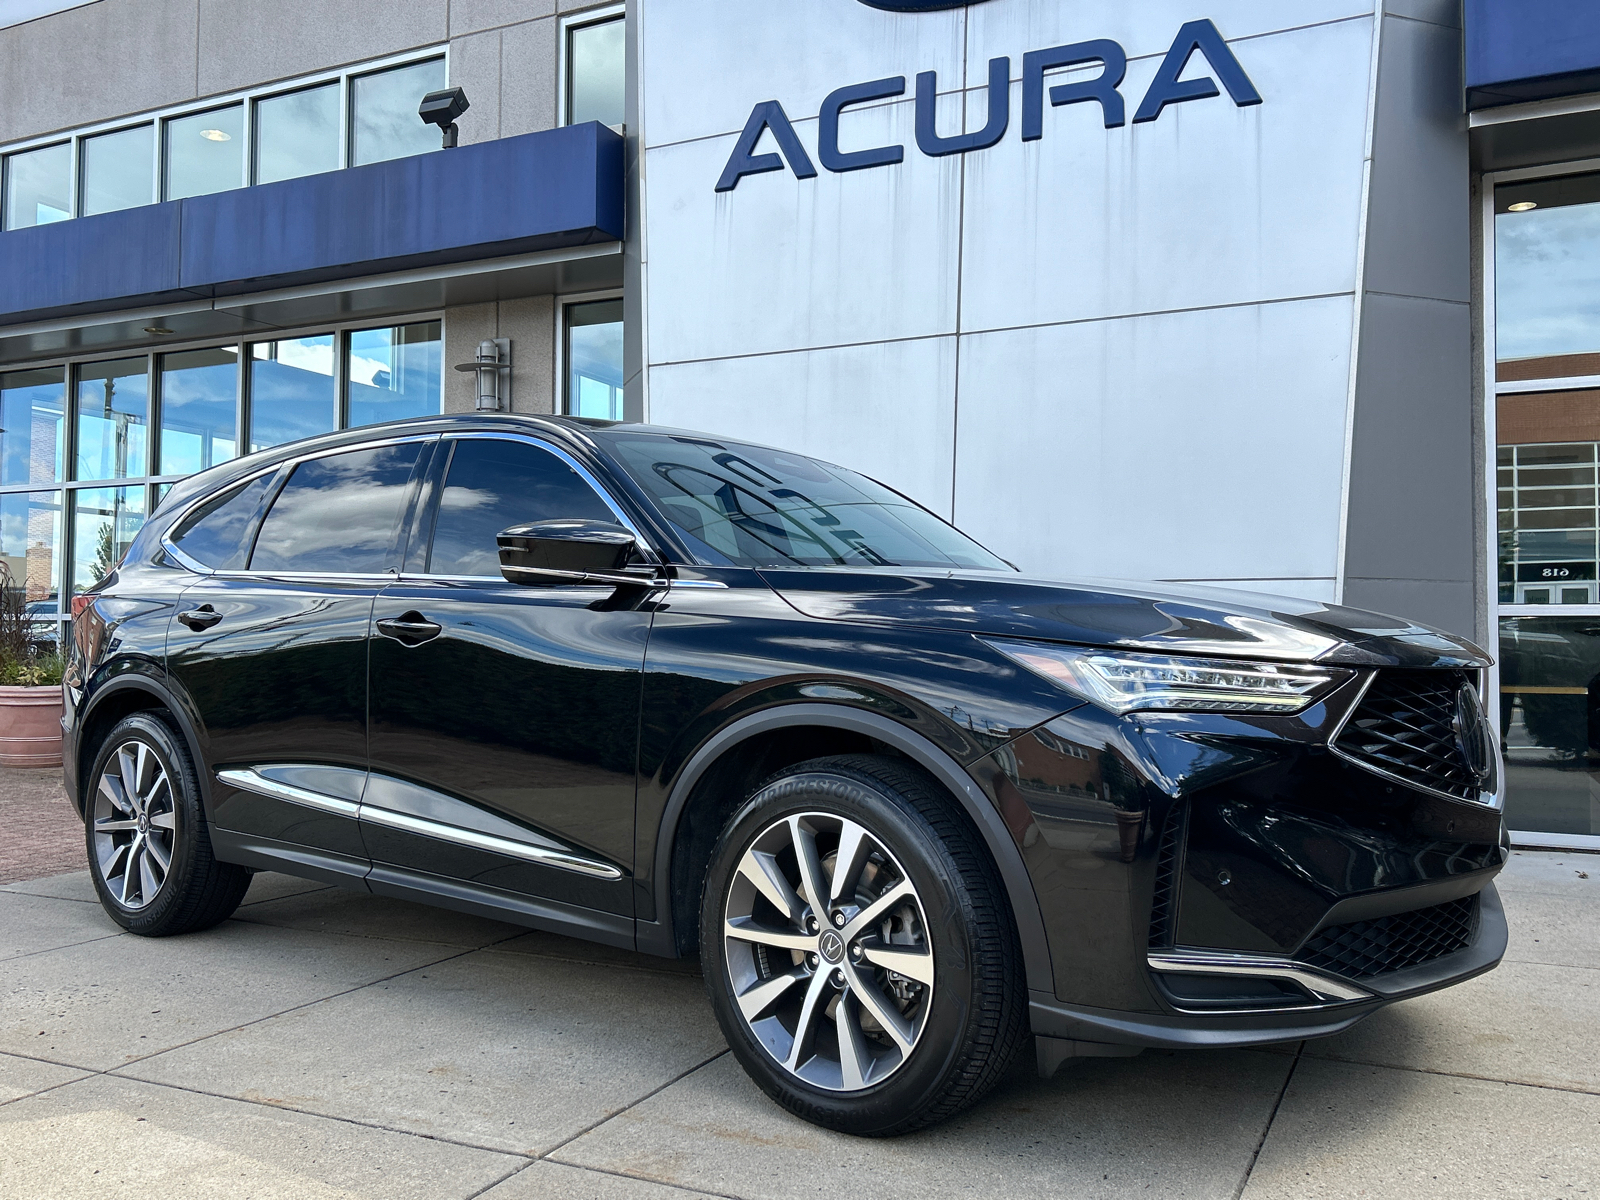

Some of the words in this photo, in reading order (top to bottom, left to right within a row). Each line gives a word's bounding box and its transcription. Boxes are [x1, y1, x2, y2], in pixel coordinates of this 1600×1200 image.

[714, 18, 1263, 193] ACURA
[755, 778, 873, 812] BRIDGESTONE
[770, 1084, 884, 1127] IDGESTONE
